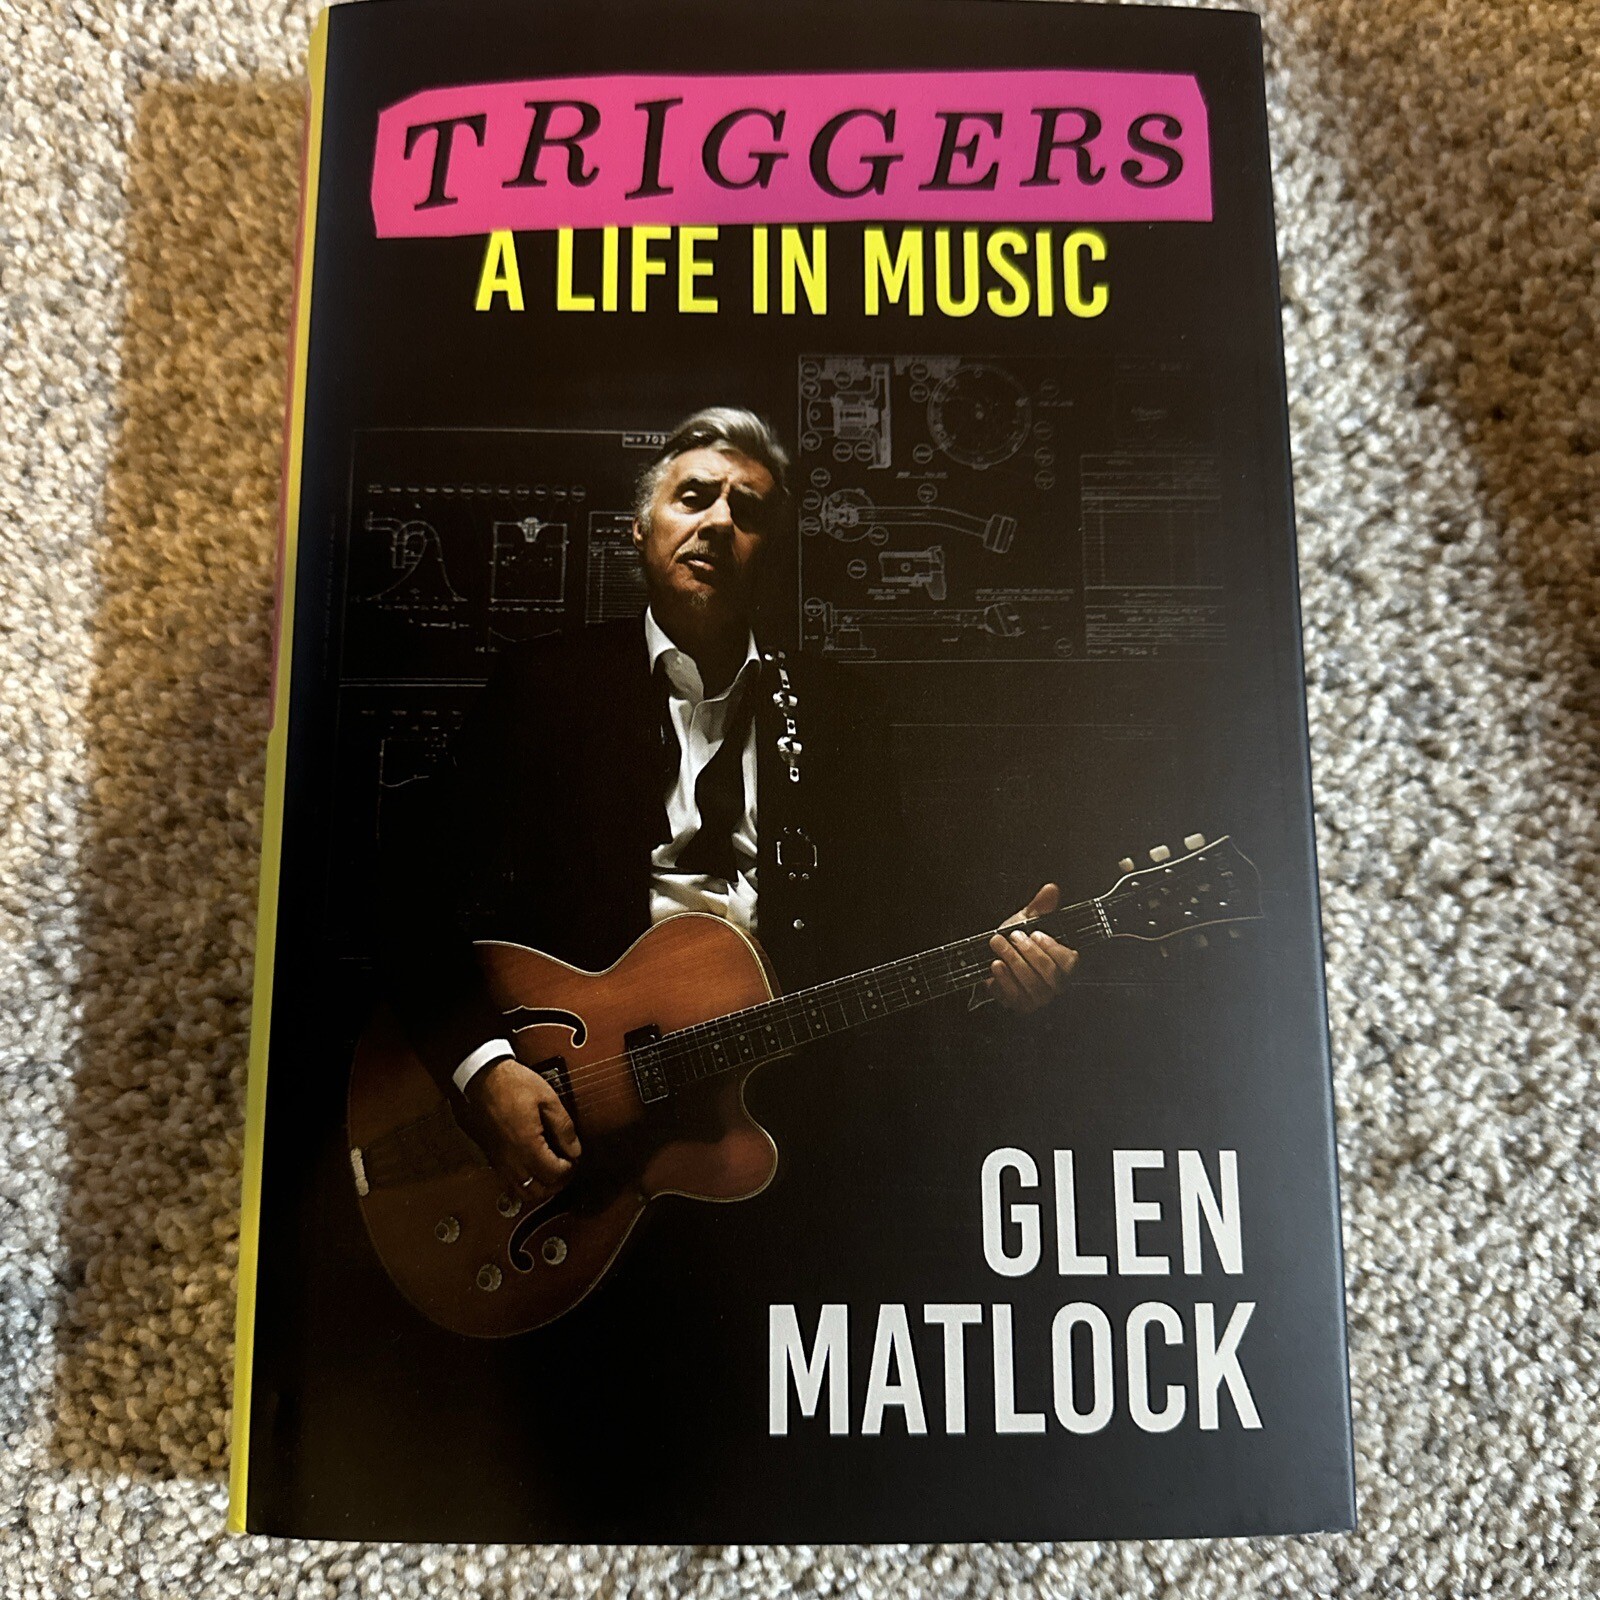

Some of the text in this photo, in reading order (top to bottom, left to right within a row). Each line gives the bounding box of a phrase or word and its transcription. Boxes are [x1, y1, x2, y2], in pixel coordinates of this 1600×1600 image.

[403, 98, 1185, 212] TRIGGERS
[475, 224, 1109, 318] A LIFE IN MUSIC
[981, 1147, 1243, 1277] GLEN
[769, 1301, 1263, 1435] MATLOCK
